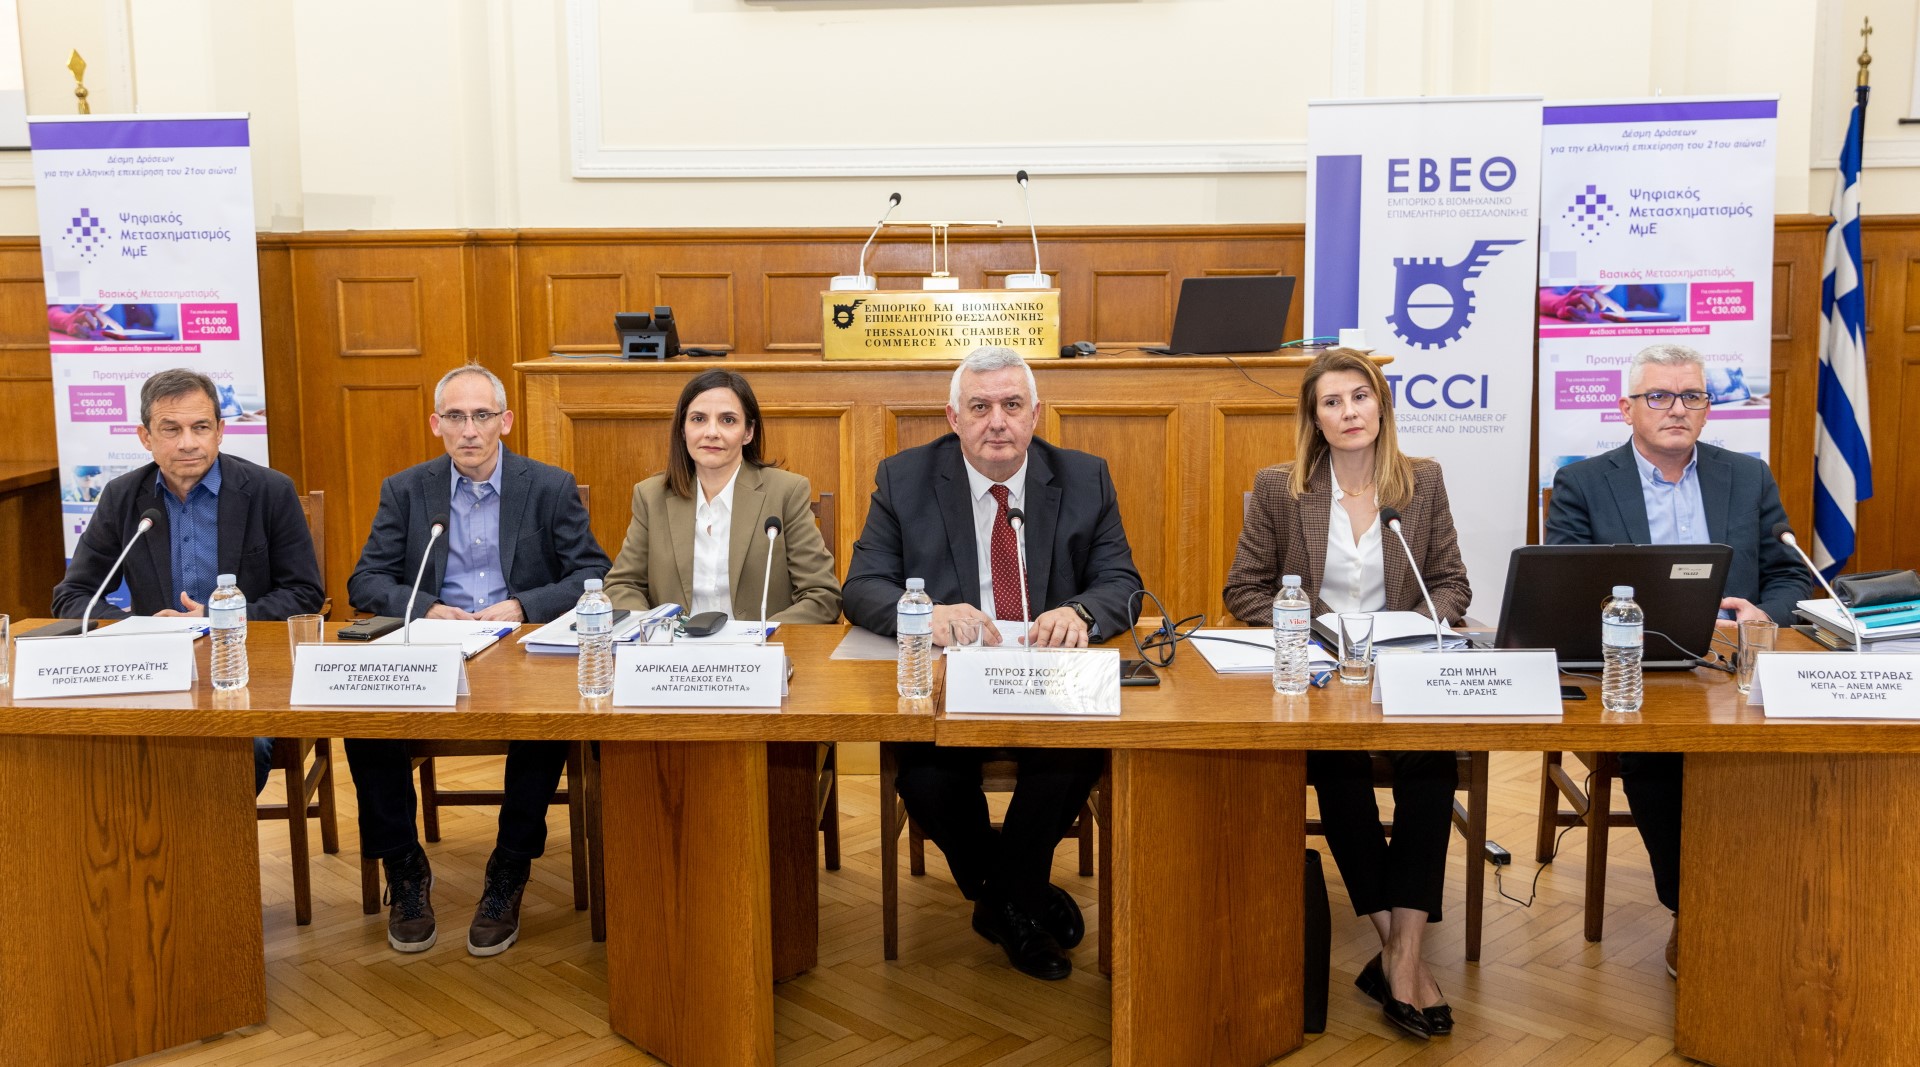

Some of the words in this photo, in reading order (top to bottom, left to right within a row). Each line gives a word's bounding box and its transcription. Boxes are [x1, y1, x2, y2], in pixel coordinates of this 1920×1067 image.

[1622, 129, 1651, 138] Δέσμη
[1653, 128, 1697, 138] Δράσεων
[1550, 145, 1565, 154] για
[1567, 144, 1584, 154] την
[1587, 142, 1629, 153] ελληνική
[1632, 142, 1684, 152] επιχείρηση
[1687, 142, 1704, 150] του
[1707, 140, 1730, 150] 21ου
[1733, 139, 1766, 148] αιώνα!
[76, 168, 116, 178] ελληνική
[117, 167, 164, 178] επιχείρηση
[166, 168, 182, 176] του
[184, 167, 206, 176] 21ου
[1388, 156, 1516, 192] ΕΒΕΘ
[1630, 187, 1700, 202] Ψηφιακός
[1388, 198, 1436, 207] ΕΜΠΟΡΙΚΟ
[1438, 198, 1444, 206] &
[1446, 196, 1512, 206] ΒΙΟΜΗΧΑΝΙΚΟ
[1387, 209, 1457, 219] ΕΠΙΜΕΛΗΤΗΡΙΟ
[1459, 208, 1528, 218] ΘΕΣΣΑΛΟΝΙΚΗΣ
[1629, 204, 1753, 219] Μετασχηματισμός
[120, 212, 183, 226] Ψηφιακός
[120, 228, 232, 242] Μετασχηματισμός
[1629, 223, 1658, 237] ΜμΕ
[122, 246, 148, 258] ΜμΕ
[1600, 268, 1642, 280] Βασικός
[1645, 266, 1736, 279] Μετασχηματισμός
[98, 288, 138, 300] Βασικός
[140, 288, 220, 300] Μετασχηματισμός
[1706, 296, 1742, 306] €18.000
[865, 304, 926, 312] ΕΜΠΟΡΙΚΟ
[934, 304, 953, 312] ΚΑΙ
[962, 302, 1044, 312] ΒΙΟΜΗΧΑΝΙΚΟ
[1711, 306, 1746, 314] €30.000
[195, 316, 227, 325] €18.000
[865, 314, 952, 322] ΕΠΙΜΕΛΗΤΗΡΙΟ
[955, 312, 1044, 322] ΘΕΣΣΑΛΟΝΙΚΗΣ
[200, 326, 232, 334] €30.000
[865, 328, 954, 337] THESSALONIKI
[962, 327, 1020, 336] CHAMBER
[1028, 327, 1044, 336] OF
[865, 338, 936, 347] COMMERCE
[945, 338, 970, 346] AND
[980, 338, 1045, 346] INDUSTRY
[1586, 354, 1632, 366] Προηγμέ
[1385, 374, 1488, 409] TCCI
[1569, 384, 1606, 394] €50.000
[80, 398, 112, 406] €50.000
[1574, 394, 1616, 402] €650.000
[1395, 413, 1447, 422] ESSALONIKI
[1448, 413, 1494, 422] CHAMBER
[1495, 413, 1507, 422] OF
[1397, 425, 1434, 434] MMERCE
[1436, 425, 1454, 434] AND
[1460, 425, 1504, 434] INDUSTRY
[38, 665, 101, 676] ΕΥΑΓΓΕΛΟΣ
[104, 662, 168, 673] ΣΤΟΥΡΑΪΤΗΣ
[314, 663, 357, 672] ΓΙΩΡΓΟΣ
[360, 663, 438, 672] ΜΠΑΤΑΓΙΑΝΝΗΣ
[635, 664, 689, 673] ΧΑΡΙΚΛΕΙΑ
[691, 664, 761, 673] ΔΕΛΗΜΗΤΣΟΥ
[984, 668, 1026, 676] ΣΠΥΡΟΣ
[1440, 668, 1463, 676] ΖΩΗ
[1466, 668, 1497, 676] ΜΗΛΗ
[52, 674, 120, 684] ΠΡΟΪΣΤΑΜΕΝΟΣ
[122, 673, 154, 682] Ε.Υ.Κ.Ε.
[348, 674, 391, 682] ΣΤΕΛΕΧΟΣ
[393, 674, 410, 682] ΕΥΔ
[670, 675, 713, 683] ΣΤΕΛΕΧΟΣ
[716, 675, 733, 683] ΕΥΔ
[1798, 670, 1858, 680] ΝΙΚΟΛΑΟΣ
[1860, 670, 1913, 680] ΣΤΡΑΒΑΣ
[989, 678, 1023, 686] ΓΕΝΙΚΟΣ
[1460, 678, 1486, 686] ΑΝΕΜ
[1488, 678, 1512, 686] ΑΜΚΕ
[329, 683, 426, 692] «ΑΝΤΑΓΩΝΙΣΤΙΚΟΤΗΤΑ»
[652, 684, 750, 692] «ΑΝΤΑΓΩΝΙΣΤΙΚΟΤΗΤΑ»
[1024, 688, 1046, 696] ΑΝΕΜ
[1446, 688, 1460, 696] Υπ.
[1463, 688, 1498, 696] ΔΡΑΣΗΣ
[1831, 692, 1848, 700] Υπ.
[1850, 692, 1887, 700] ΔΡΑΣΗΣ
